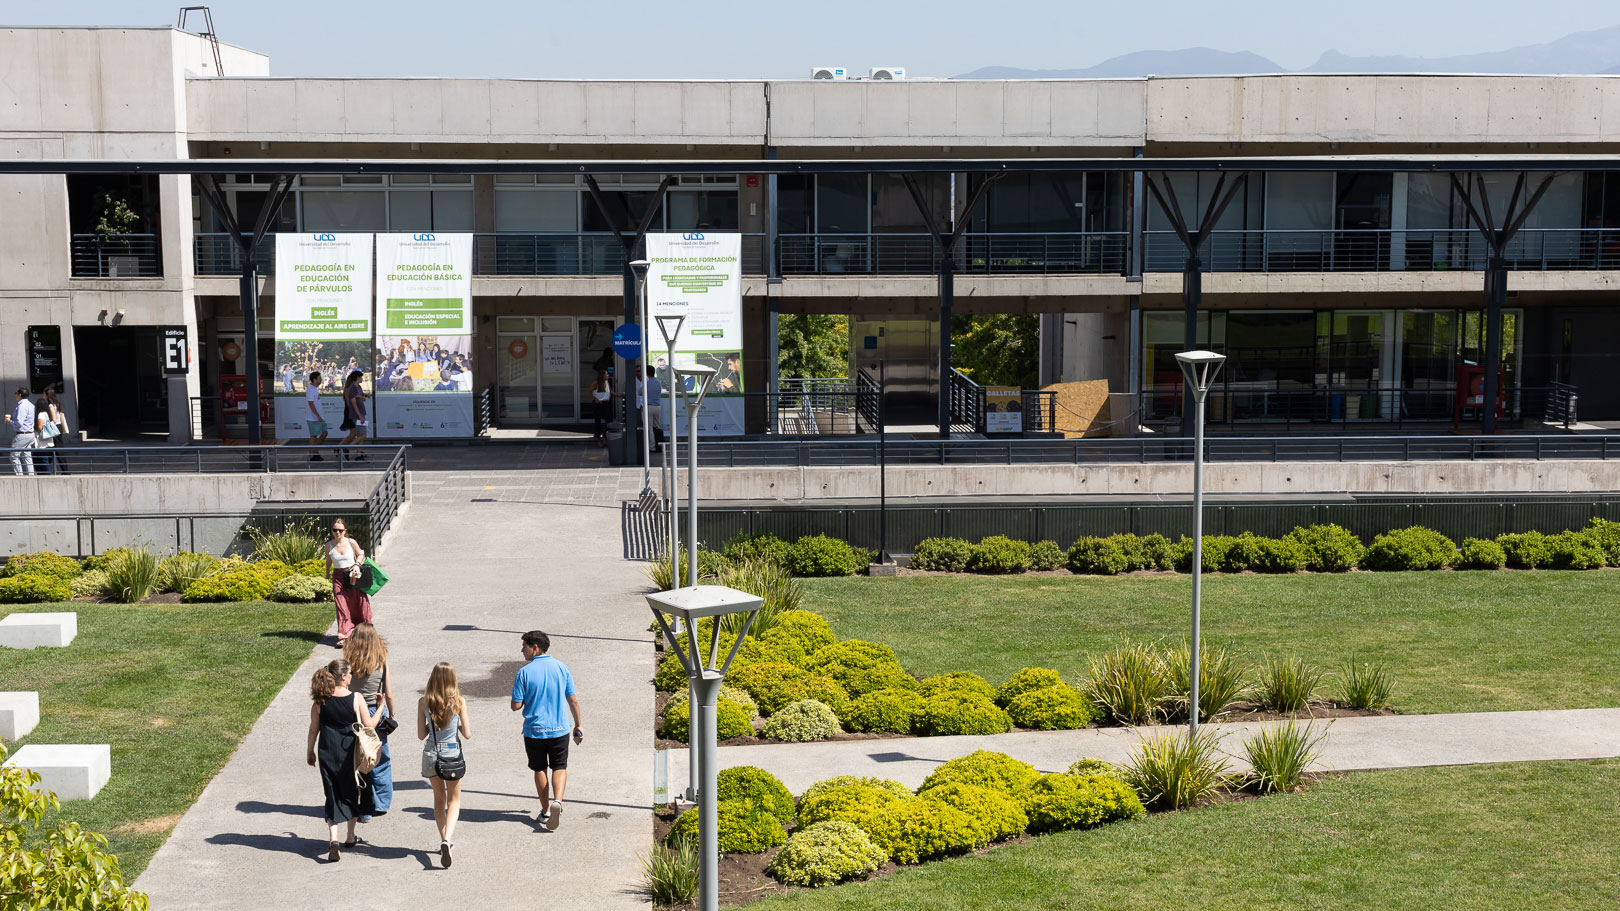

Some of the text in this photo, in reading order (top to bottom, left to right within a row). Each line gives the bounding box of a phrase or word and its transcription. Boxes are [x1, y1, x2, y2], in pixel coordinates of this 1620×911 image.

[294, 263, 342, 271] PEDAGOGÍA
[397, 263, 440, 271] PEDAGOGÍA
[300, 273, 349, 282] EDUCACIÓN
[309, 284, 352, 292] PÁRVULOS
[165, 338, 186, 368] E1
